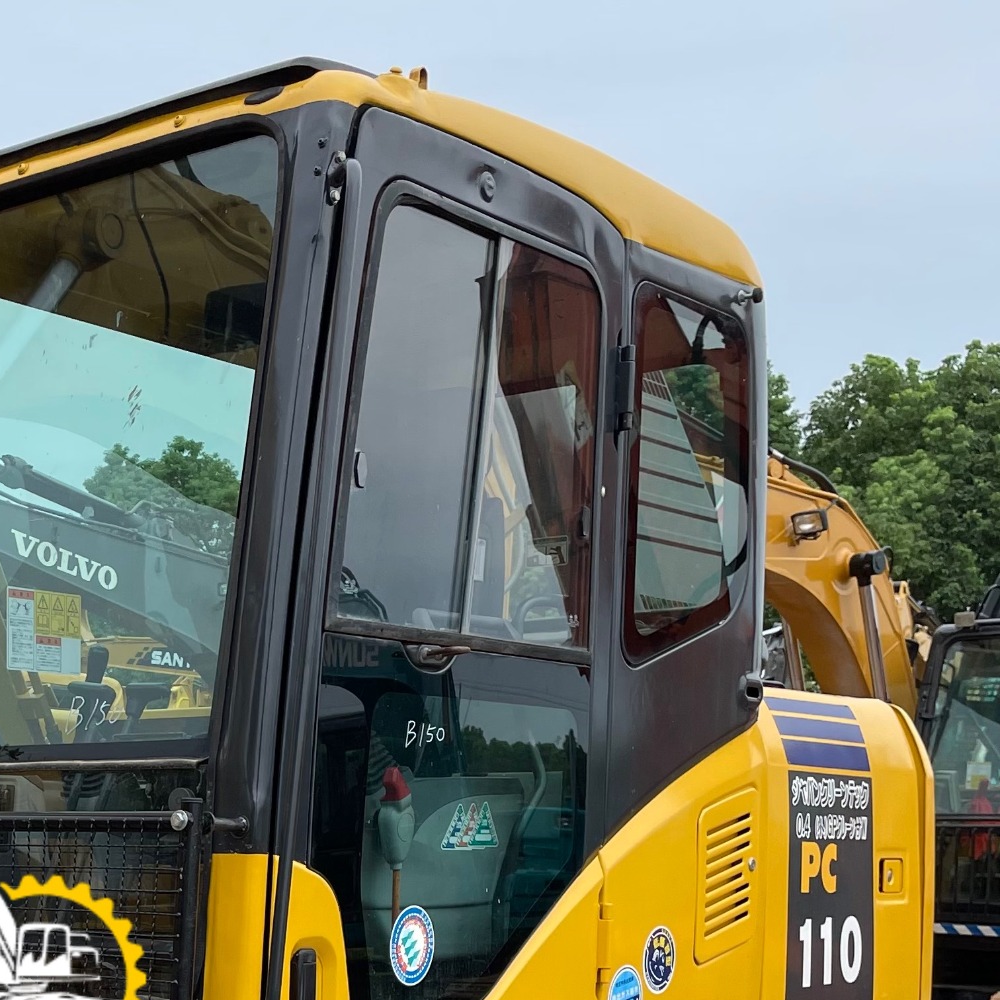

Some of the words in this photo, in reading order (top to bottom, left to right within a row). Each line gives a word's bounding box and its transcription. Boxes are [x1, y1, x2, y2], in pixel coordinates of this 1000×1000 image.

[11, 529, 118, 590] VOLVO
[150, 651, 191, 669] SAN
[405, 720, 445, 748] B150
[800, 841, 838, 894] PC
[799, 915, 863, 988] 110
